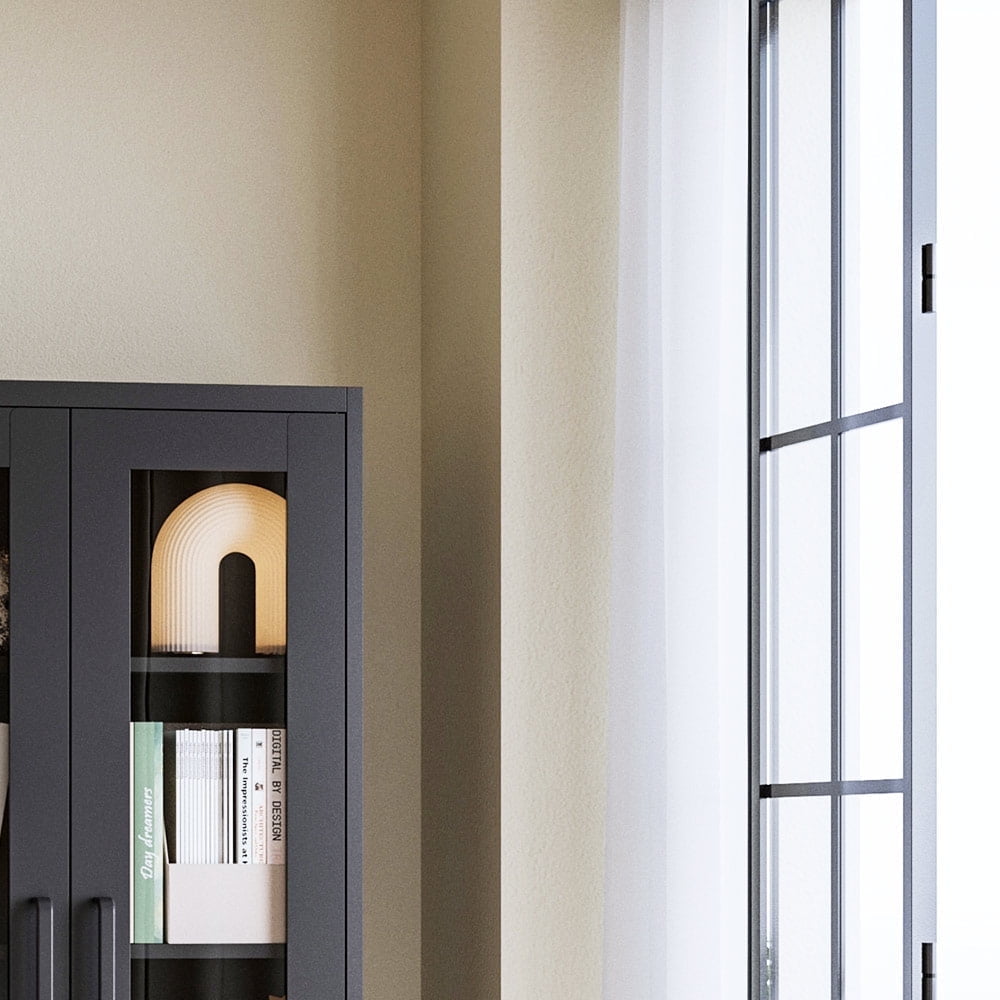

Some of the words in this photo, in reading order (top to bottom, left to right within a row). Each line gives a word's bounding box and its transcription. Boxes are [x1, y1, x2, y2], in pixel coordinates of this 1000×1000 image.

[271, 729, 282, 774] DIGITAL
[271, 781, 282, 794] BY
[138, 787, 154, 848] dreamers
[241, 777, 249, 846] Impressionists
[271, 801, 282, 842] DESIGN
[140, 848, 155, 881] Day
[242, 848, 249, 859] at
